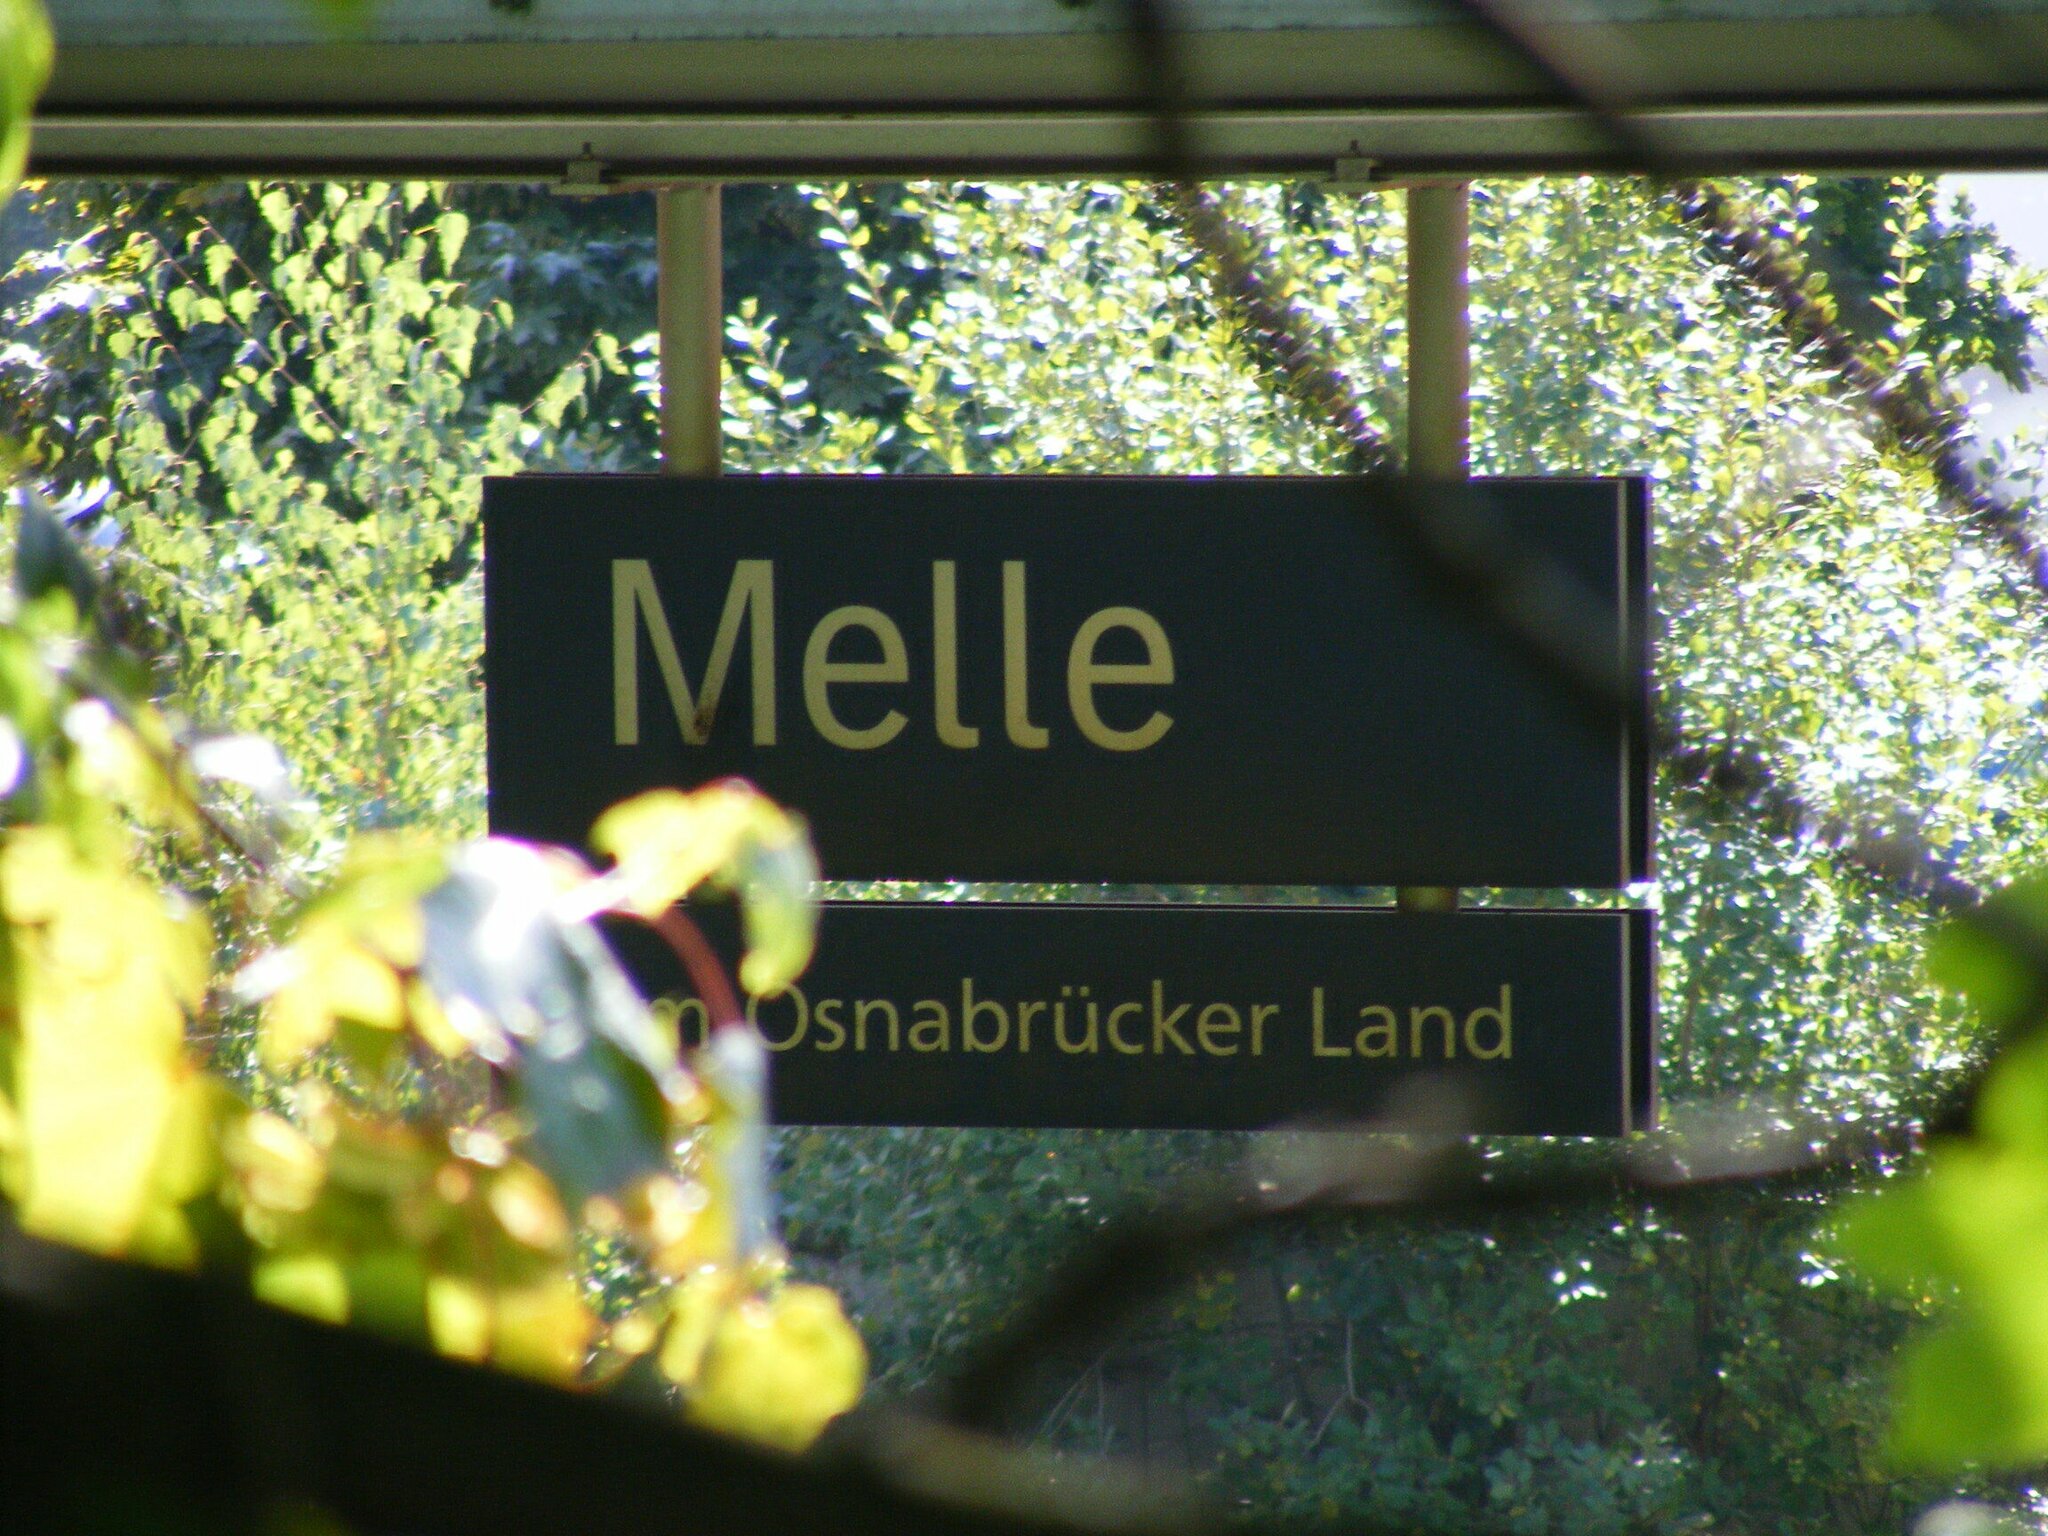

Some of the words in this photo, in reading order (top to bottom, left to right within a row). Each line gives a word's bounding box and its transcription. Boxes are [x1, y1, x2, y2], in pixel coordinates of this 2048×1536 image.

[611, 558, 1176, 752] Melle
[745, 976, 1279, 1055] Osnabrücker
[1312, 984, 1514, 1060] Land
